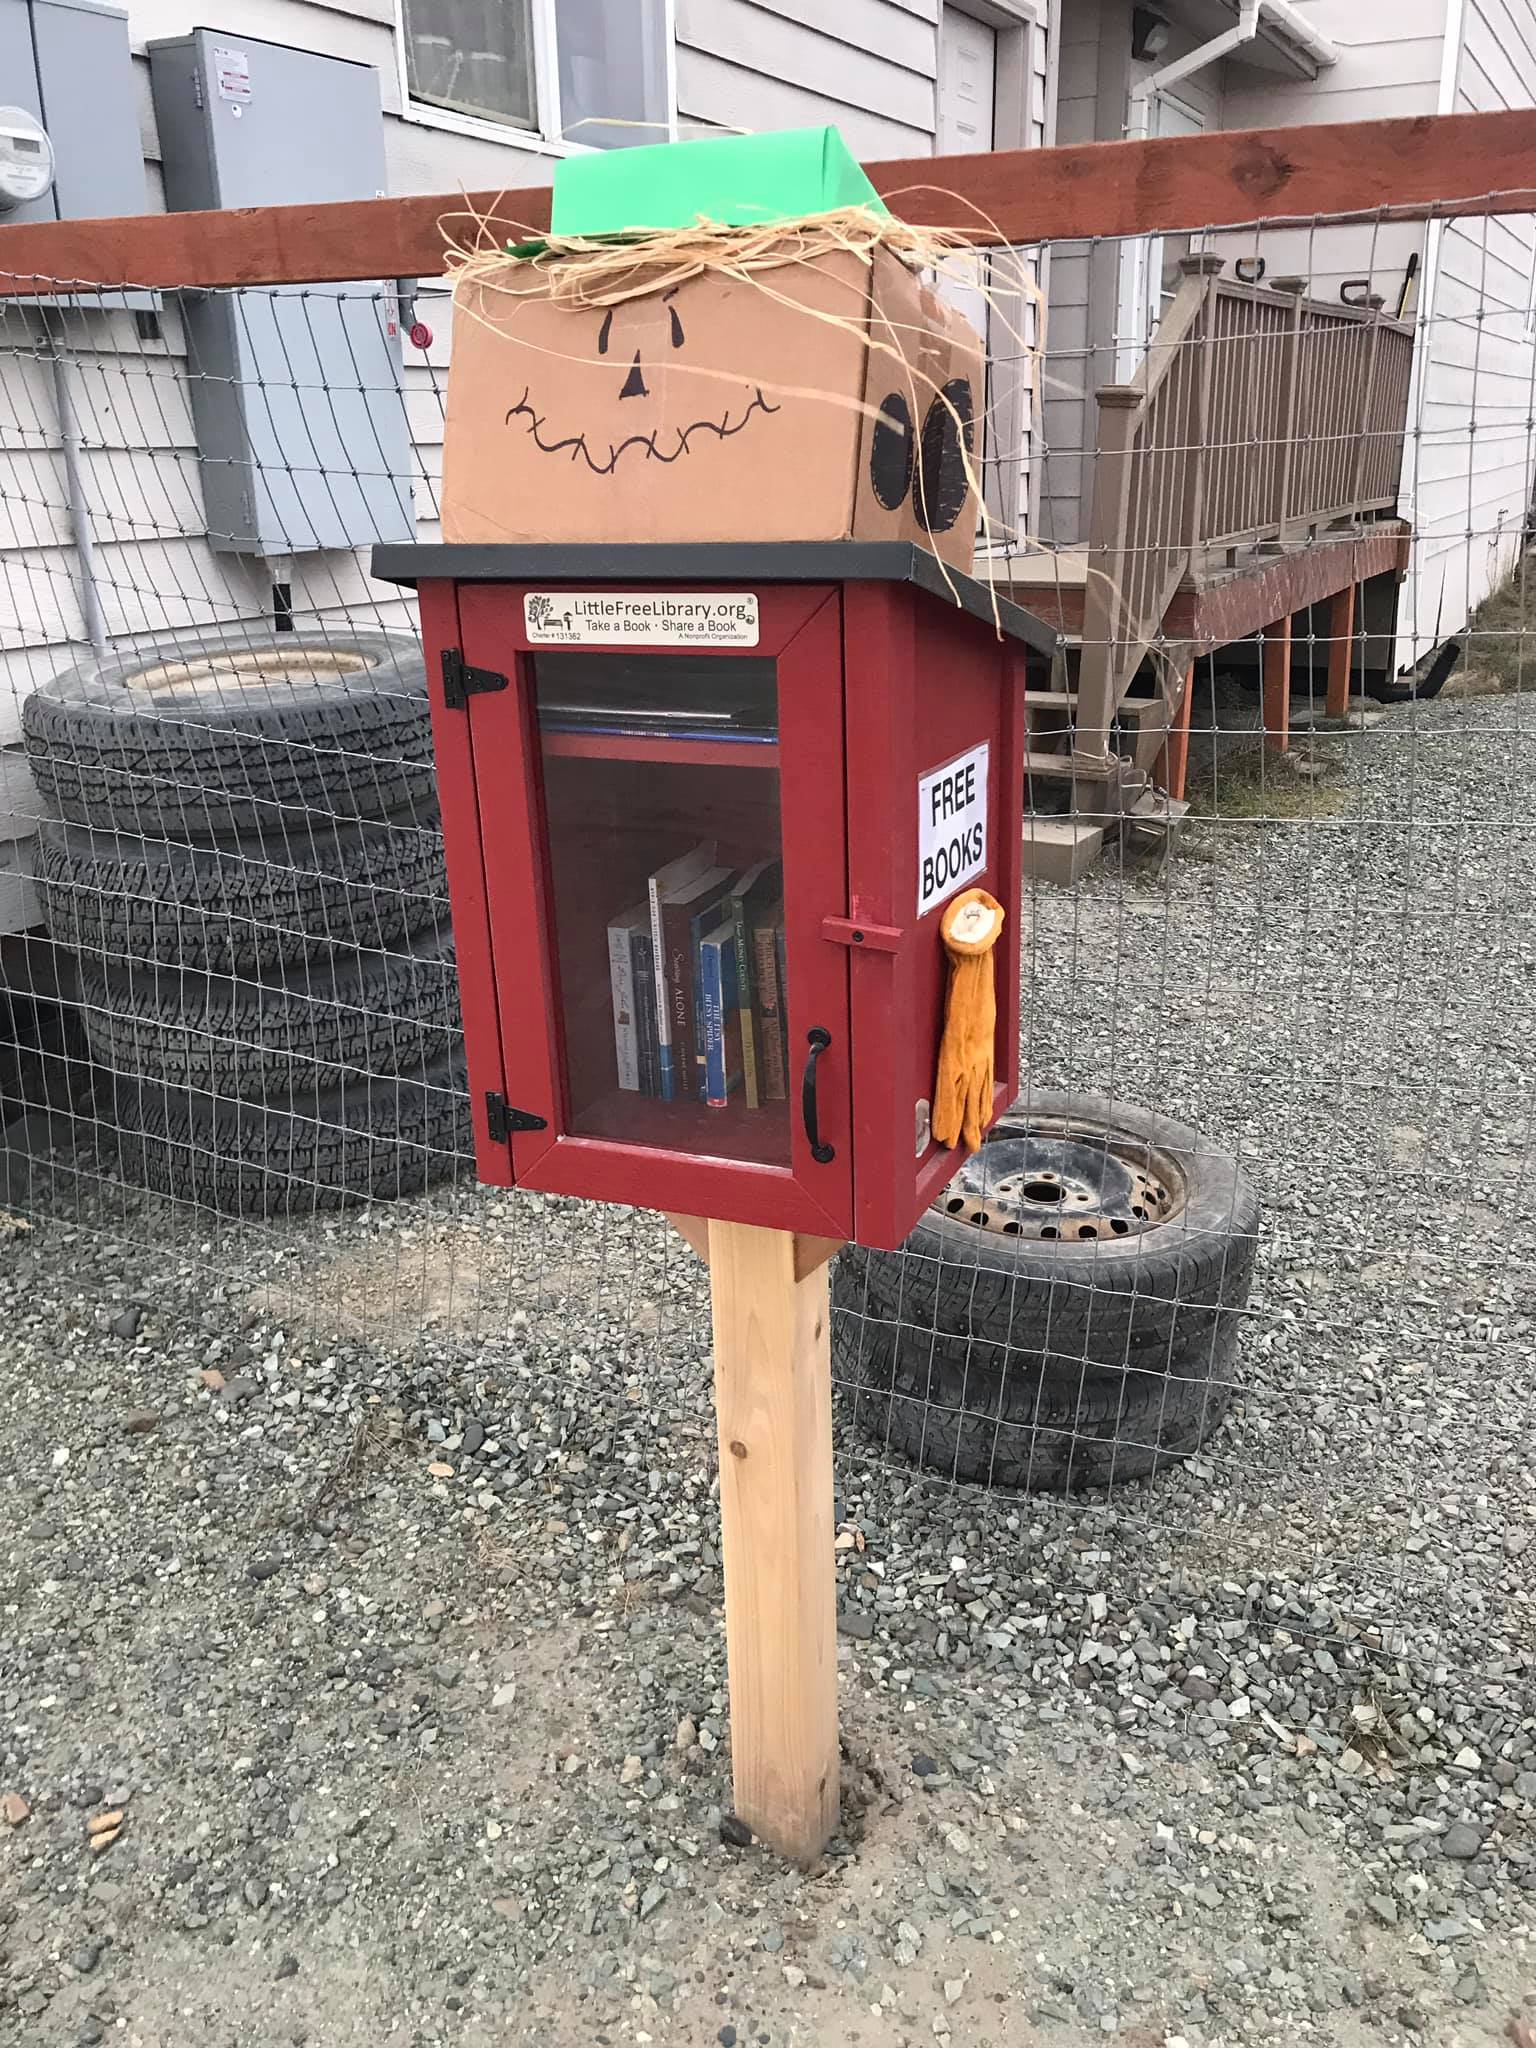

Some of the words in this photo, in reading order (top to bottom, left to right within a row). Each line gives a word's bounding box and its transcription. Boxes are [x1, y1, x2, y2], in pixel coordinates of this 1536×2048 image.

[575, 600, 746, 620] LittleFreeLibrary.org
[585, 619, 610, 632] Take
[614, 622, 620, 631] a
[624, 620, 651, 632] Book
[662, 619, 694, 632] Share
[698, 622, 704, 631] a
[708, 620, 737, 632] Book
[711, 632, 748, 641] Organization
[932, 763, 975, 827] FREE
[923, 822, 983, 900] BOOKS
